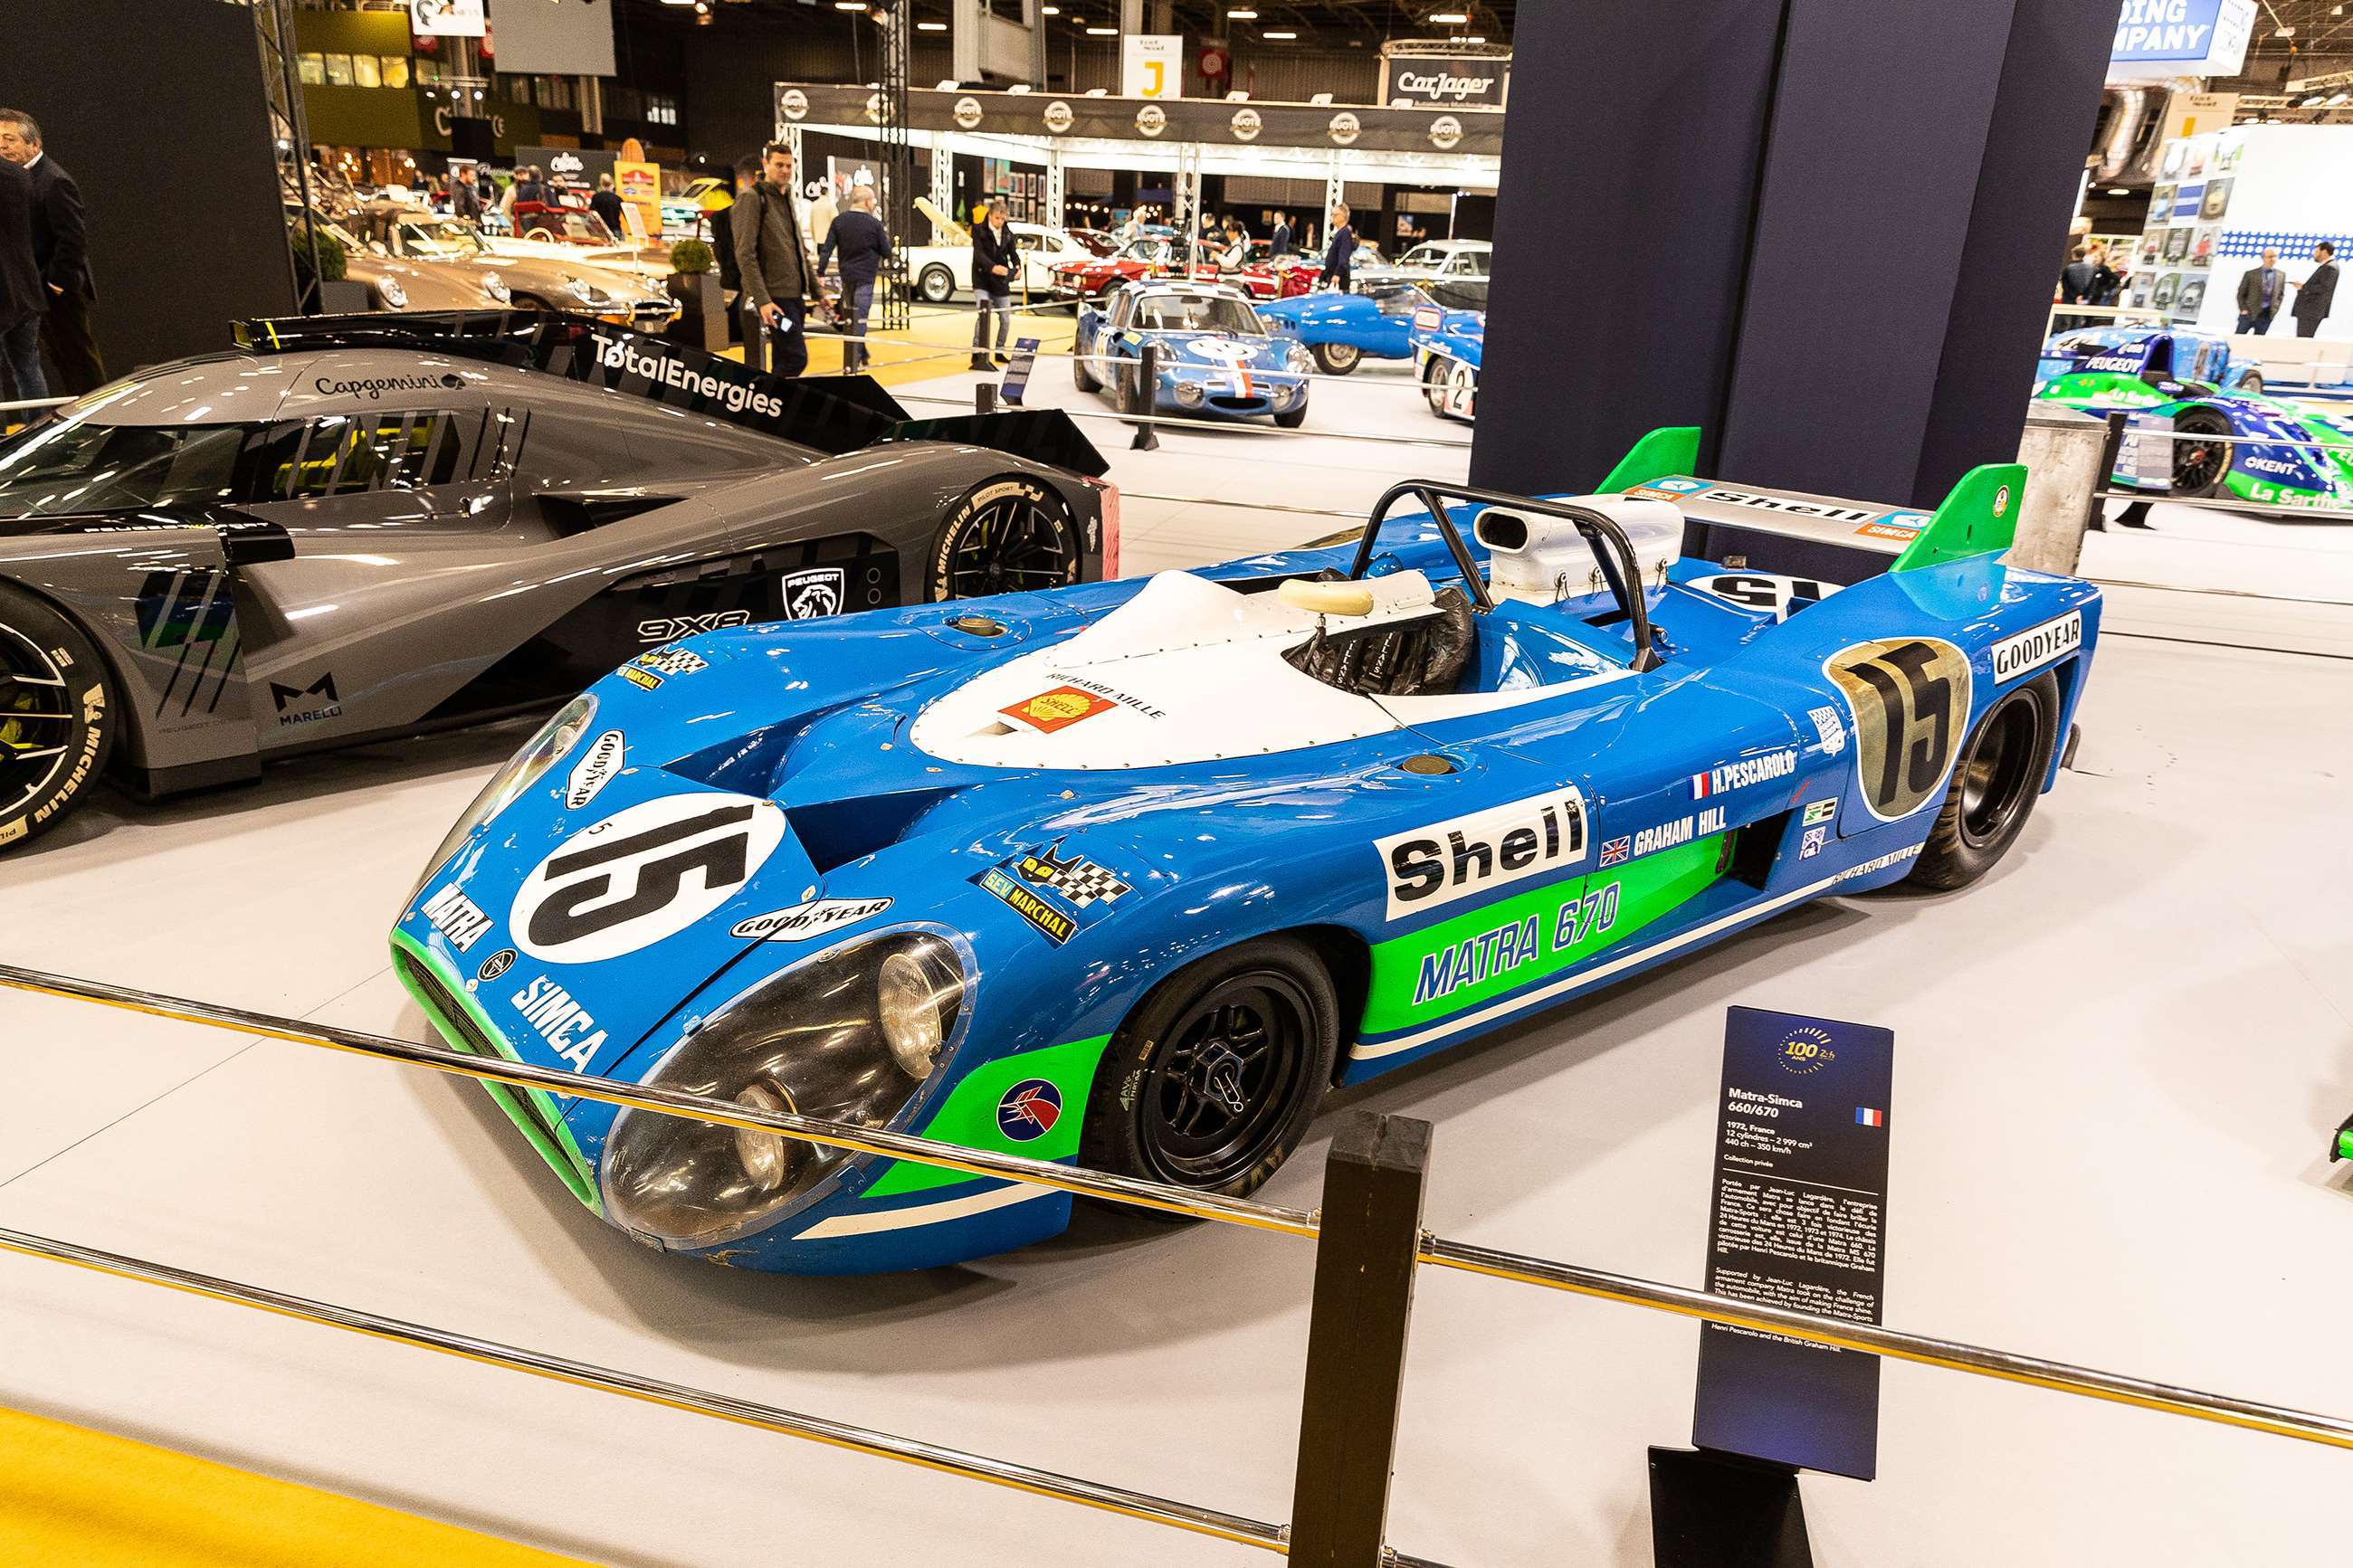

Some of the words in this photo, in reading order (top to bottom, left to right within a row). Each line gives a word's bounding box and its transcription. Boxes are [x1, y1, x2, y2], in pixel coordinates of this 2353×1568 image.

[1141, 61, 1164, 98] J
[1397, 71, 1494, 100] CarJager
[315, 374, 442, 400] Capgemini
[591, 333, 784, 419] TotalEnergies
[1706, 492, 1869, 521] Shell
[2251, 482, 2274, 501] La
[938, 505, 972, 575] MICHELIN
[1866, 526, 1918, 539] SIMCA
[787, 573, 840, 588] PEUGEOT
[1373, 632, 1394, 675] ILLANS
[1996, 622, 2081, 675] GOODYEAR
[1046, 673, 1114, 695] RICHARD
[1114, 693, 1166, 719] MILLE
[280, 706, 342, 726] MARELLI
[1844, 641, 1951, 807] 15
[34, 727, 101, 823] MICHELIN
[571, 733, 619, 808] GOODYEAR
[1711, 750, 1796, 796] H.PESCAROLO
[1634, 815, 1692, 856] GRAHAM
[1698, 806, 1727, 841] HILL
[1391, 799, 1583, 902] Shell
[529, 803, 755, 946] 15
[421, 882, 493, 953] MATRA
[737, 898, 888, 936] GOODYEAR
[985, 870, 1013, 898] SEV
[1009, 889, 1069, 938] MARCHAL
[1413, 914, 1538, 1006] MATRA
[1552, 883, 1619, 951] 670
[511, 976, 608, 1074] SIMCA
[1785, 1041, 1819, 1059] 100
[1728, 1088, 1804, 1109] Matra-Simca
[1728, 1101, 1779, 1118] 660/670
[1725, 1137, 1739, 1146] 440
[1740, 1140, 1749, 1148] ch
[1757, 1143, 1771, 1152] 350
[1772, 1145, 1792, 1155] km/h
[1726, 1129, 1735, 1137] 12
[1737, 1130, 1769, 1143] cylindres
[1782, 1138, 1796, 1147] 999
[1749, 1124, 1776, 1136] France
[1723, 1154, 1753, 1164] Collection
[1754, 1159, 1773, 1167] privée
[1715, 1267, 1748, 1278] Supported
[1752, 1273, 1760, 1281] by
[1766, 1276, 1793, 1286] Jean-Luc
[1853, 1291, 1873, 1300] French
[1715, 1275, 1745, 1285] armament
[1747, 1280, 1775, 1290] company
[1776, 1285, 1795, 1293] Matra
[1796, 1288, 1810, 1297] took
[1834, 1296, 1864, 1306] challenge
[1725, 1284, 1761, 1295] automobile,
[1808, 1299, 1832, 1307] making
[1833, 1301, 1853, 1311] France
[1854, 1306, 1872, 1315] shine.
[1713, 1288, 1726, 1297] This
[1739, 1292, 1755, 1300] been
[1755, 1297, 1783, 1306] achieved
[1783, 1300, 1791, 1308] by
[1792, 1302, 1820, 1313] founding
[1821, 1307, 1832, 1315] the
[1833, 1308, 1872, 1322] Matra-Sports
[1710, 1323, 1728, 1331] Henri
[1729, 1326, 1758, 1336] Pescarolo
[1783, 1335, 1803, 1345] British
[1803, 1338, 1828, 1350] Graham
[1829, 1344, 1842, 1353] Hill.
